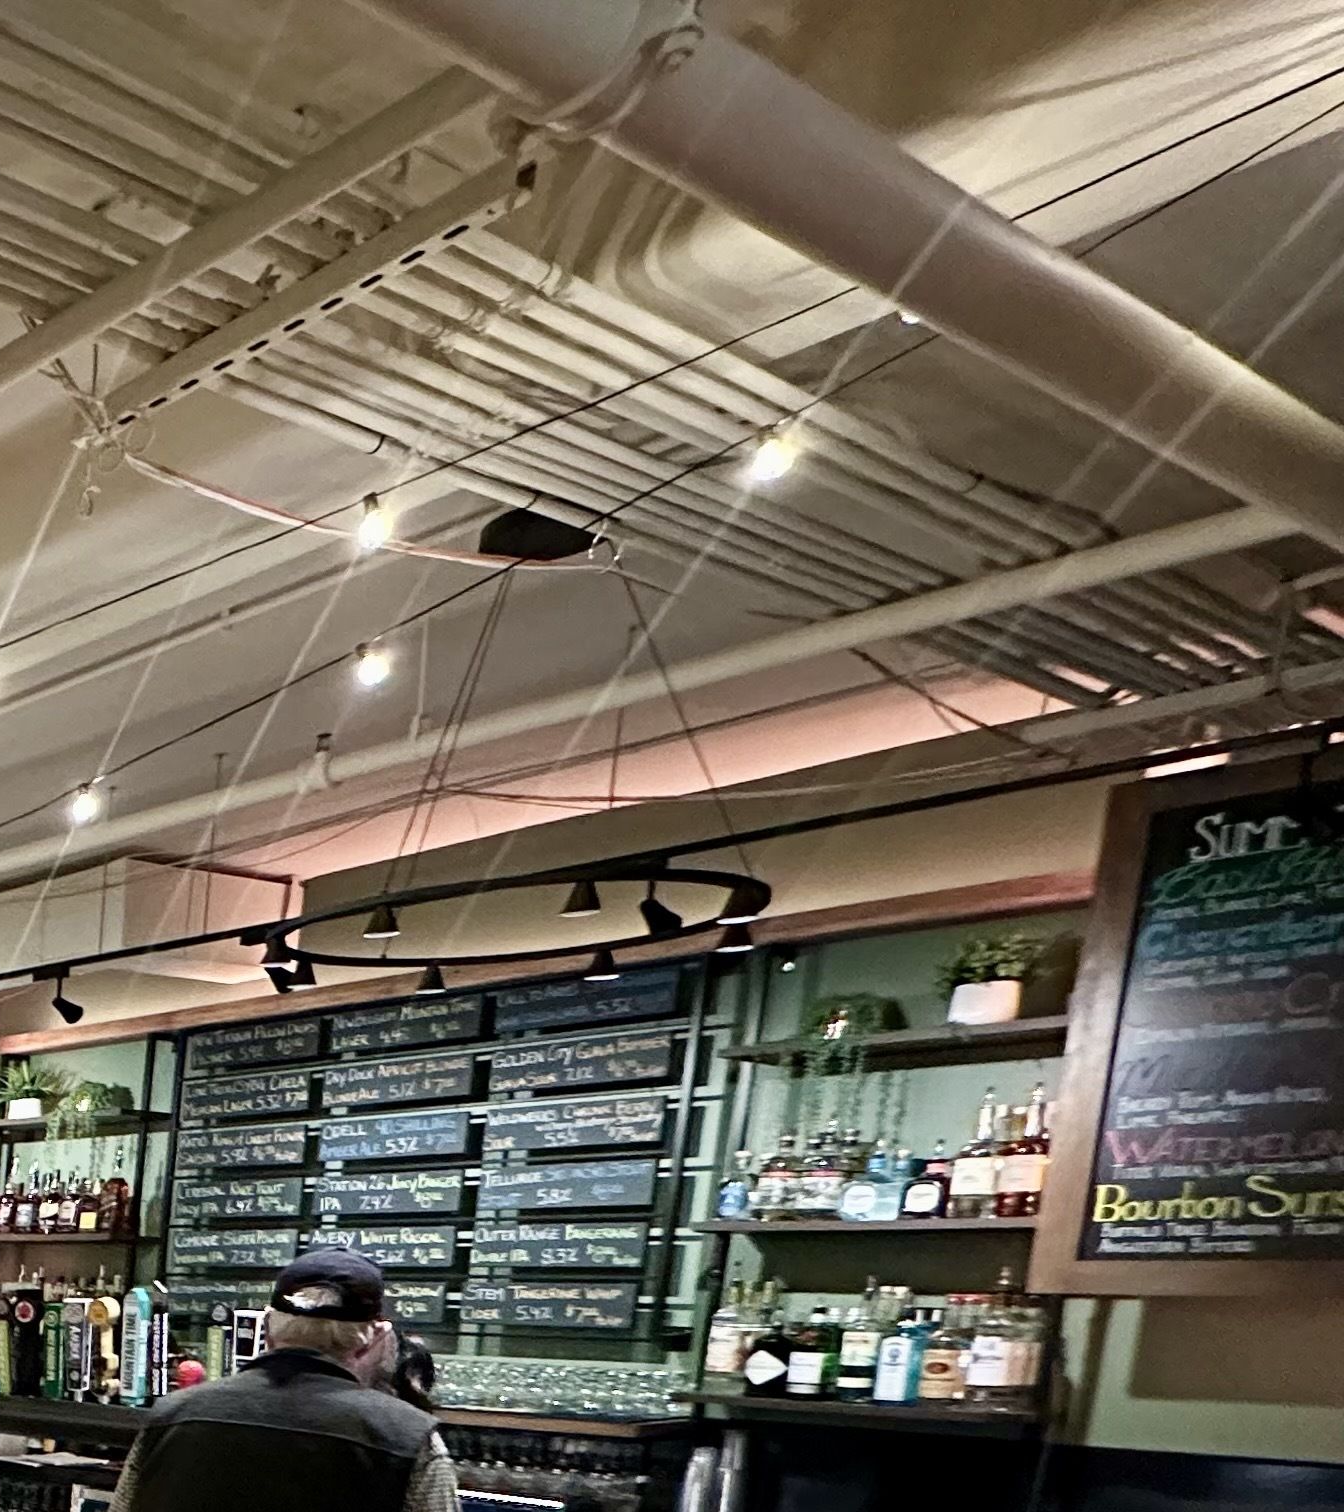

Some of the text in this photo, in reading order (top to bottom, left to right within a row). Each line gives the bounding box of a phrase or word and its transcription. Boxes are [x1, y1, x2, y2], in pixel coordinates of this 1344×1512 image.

[322, 1124, 368, 1141] ODELL
[316, 1177, 367, 1193] STATION
[319, 1196, 342, 1212] IPA
[1093, 1181, 1244, 1222] Bourbon
[312, 1229, 356, 1248] AVERY
[464, 1283, 506, 1301] STEM
[123, 1311, 138, 1391] MOUNTAIN TIME
